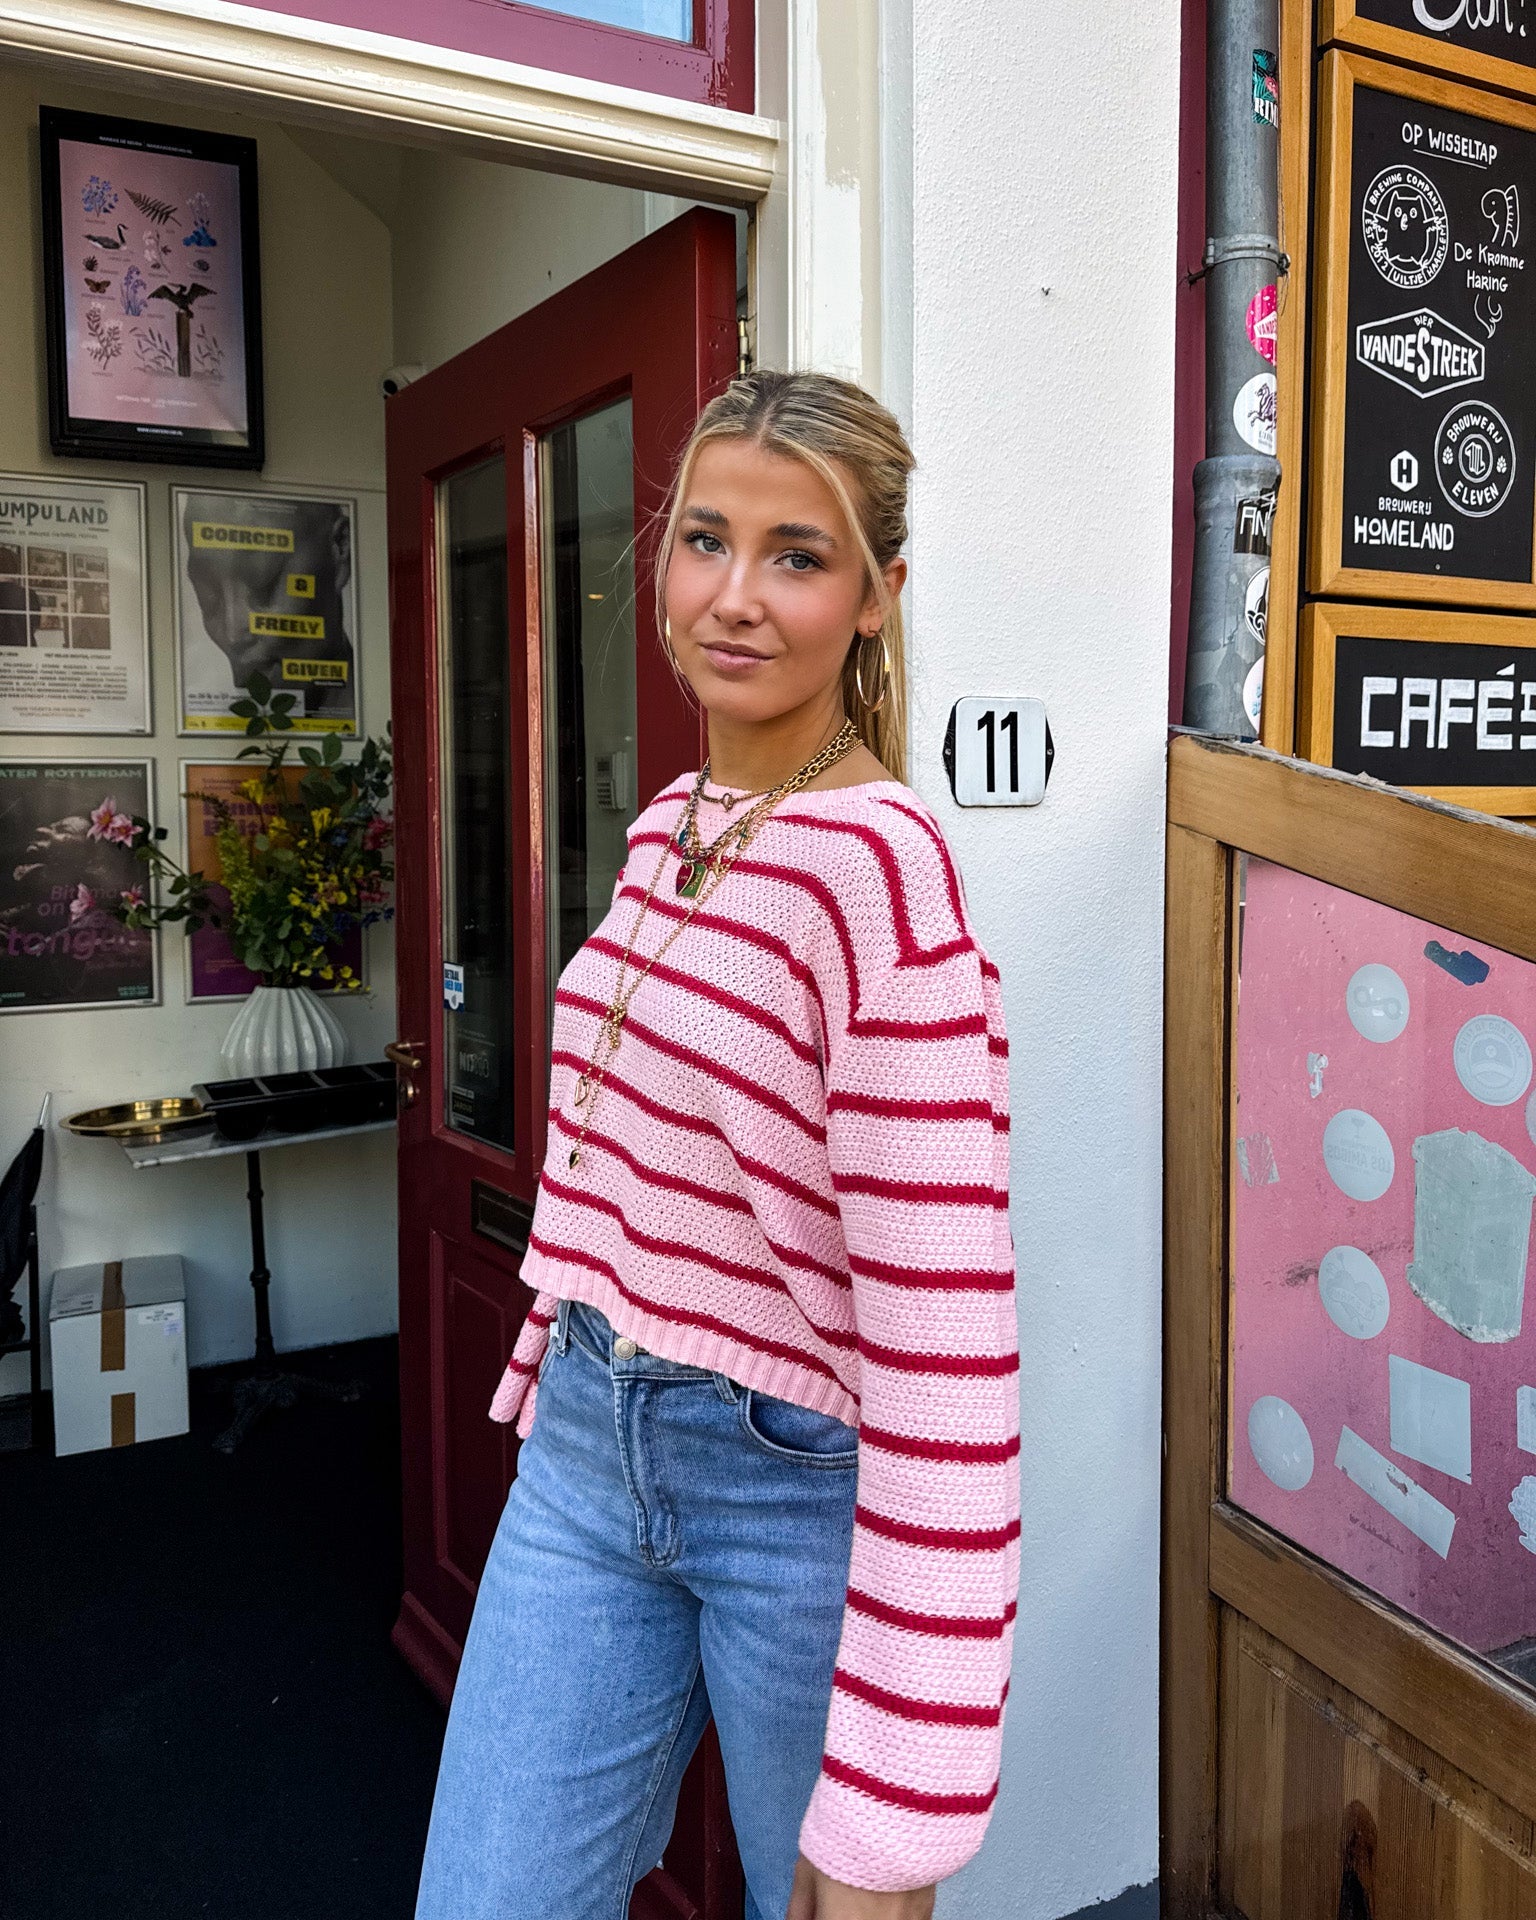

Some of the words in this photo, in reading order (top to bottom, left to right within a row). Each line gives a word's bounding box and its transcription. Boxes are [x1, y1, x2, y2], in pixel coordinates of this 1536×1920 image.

[1401, 122, 1423, 146] OP
[1429, 128, 1497, 165] WISSELTAP
[1369, 173, 1402, 205] BREWING
[1407, 173, 1442, 213] COMPANY
[1365, 218, 1375, 240] EST
[1370, 245, 1388, 271] 2012
[1454, 242, 1473, 262] De
[1393, 270, 1424, 285] UILTJE
[1414, 315, 1434, 328] BIER
[1446, 412, 1503, 444] BROUWERIJ
[1397, 458, 1413, 484] H
[1451, 480, 1500, 506] ELEVEN
[1378, 496, 1432, 516] BROUWERIJ
[201, 526, 290, 548] COERCED
[1354, 516, 1455, 550] HOMELAND
[295, 577, 308, 592] &
[254, 616, 321, 635] FREELY
[286, 662, 344, 678] GIVEN
[977, 710, 1019, 793] 11
[44, 768, 143, 779] ROTTERDAM
